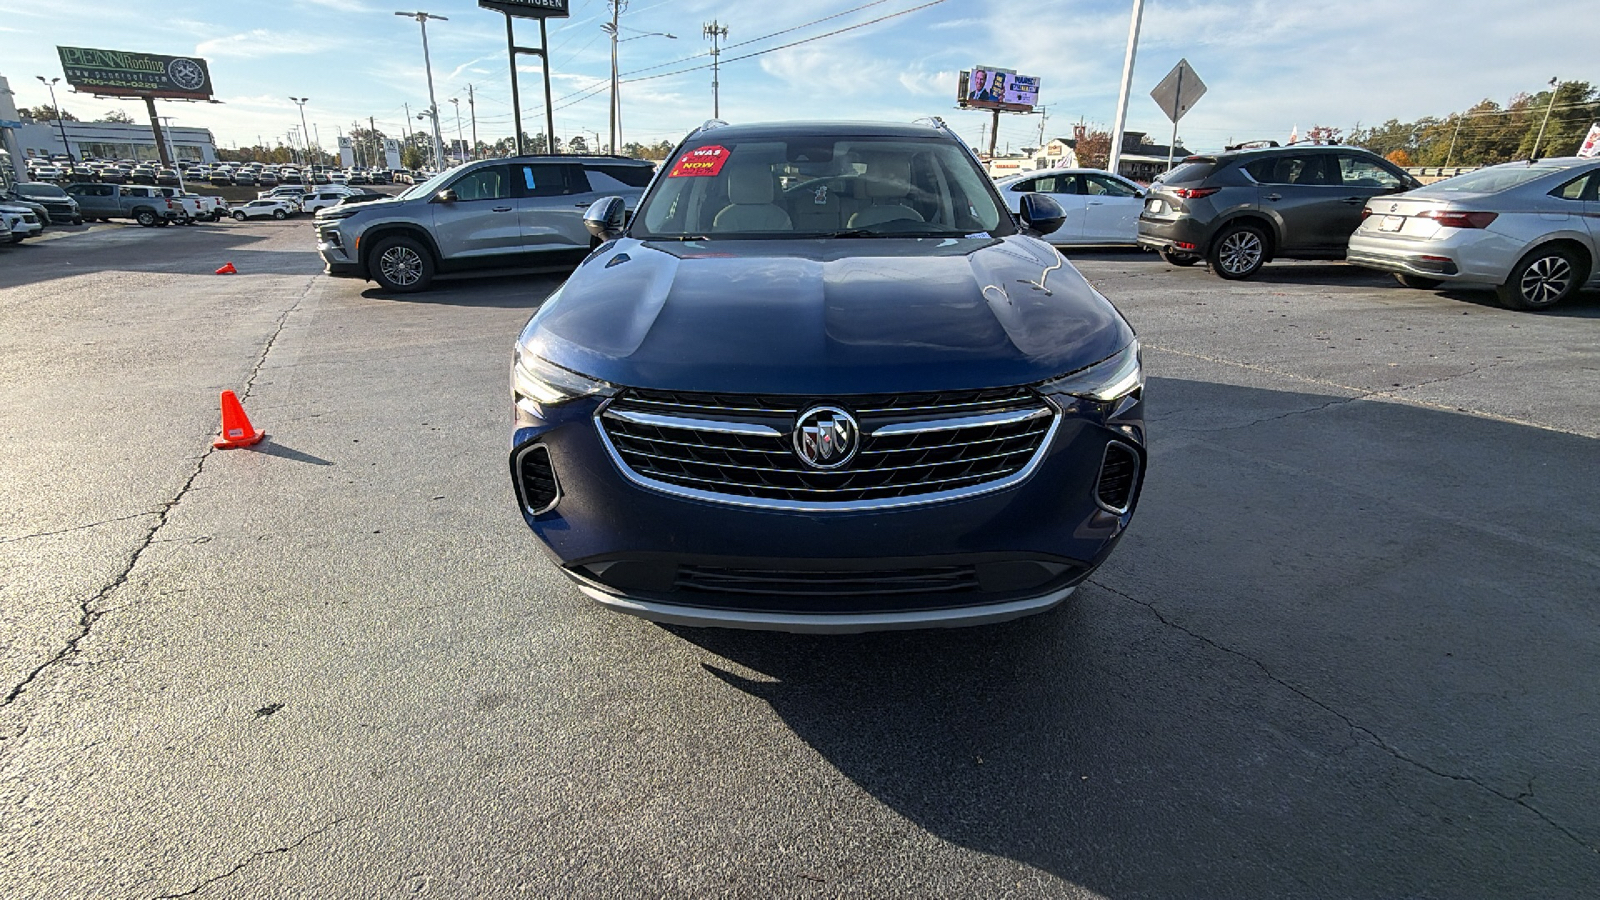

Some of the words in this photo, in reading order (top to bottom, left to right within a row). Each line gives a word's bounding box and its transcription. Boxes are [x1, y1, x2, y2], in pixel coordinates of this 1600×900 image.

[64, 49, 130, 67] PENN
[125, 55, 166, 74] Roofing
[67, 69, 168, 82] www.pennroof.com
